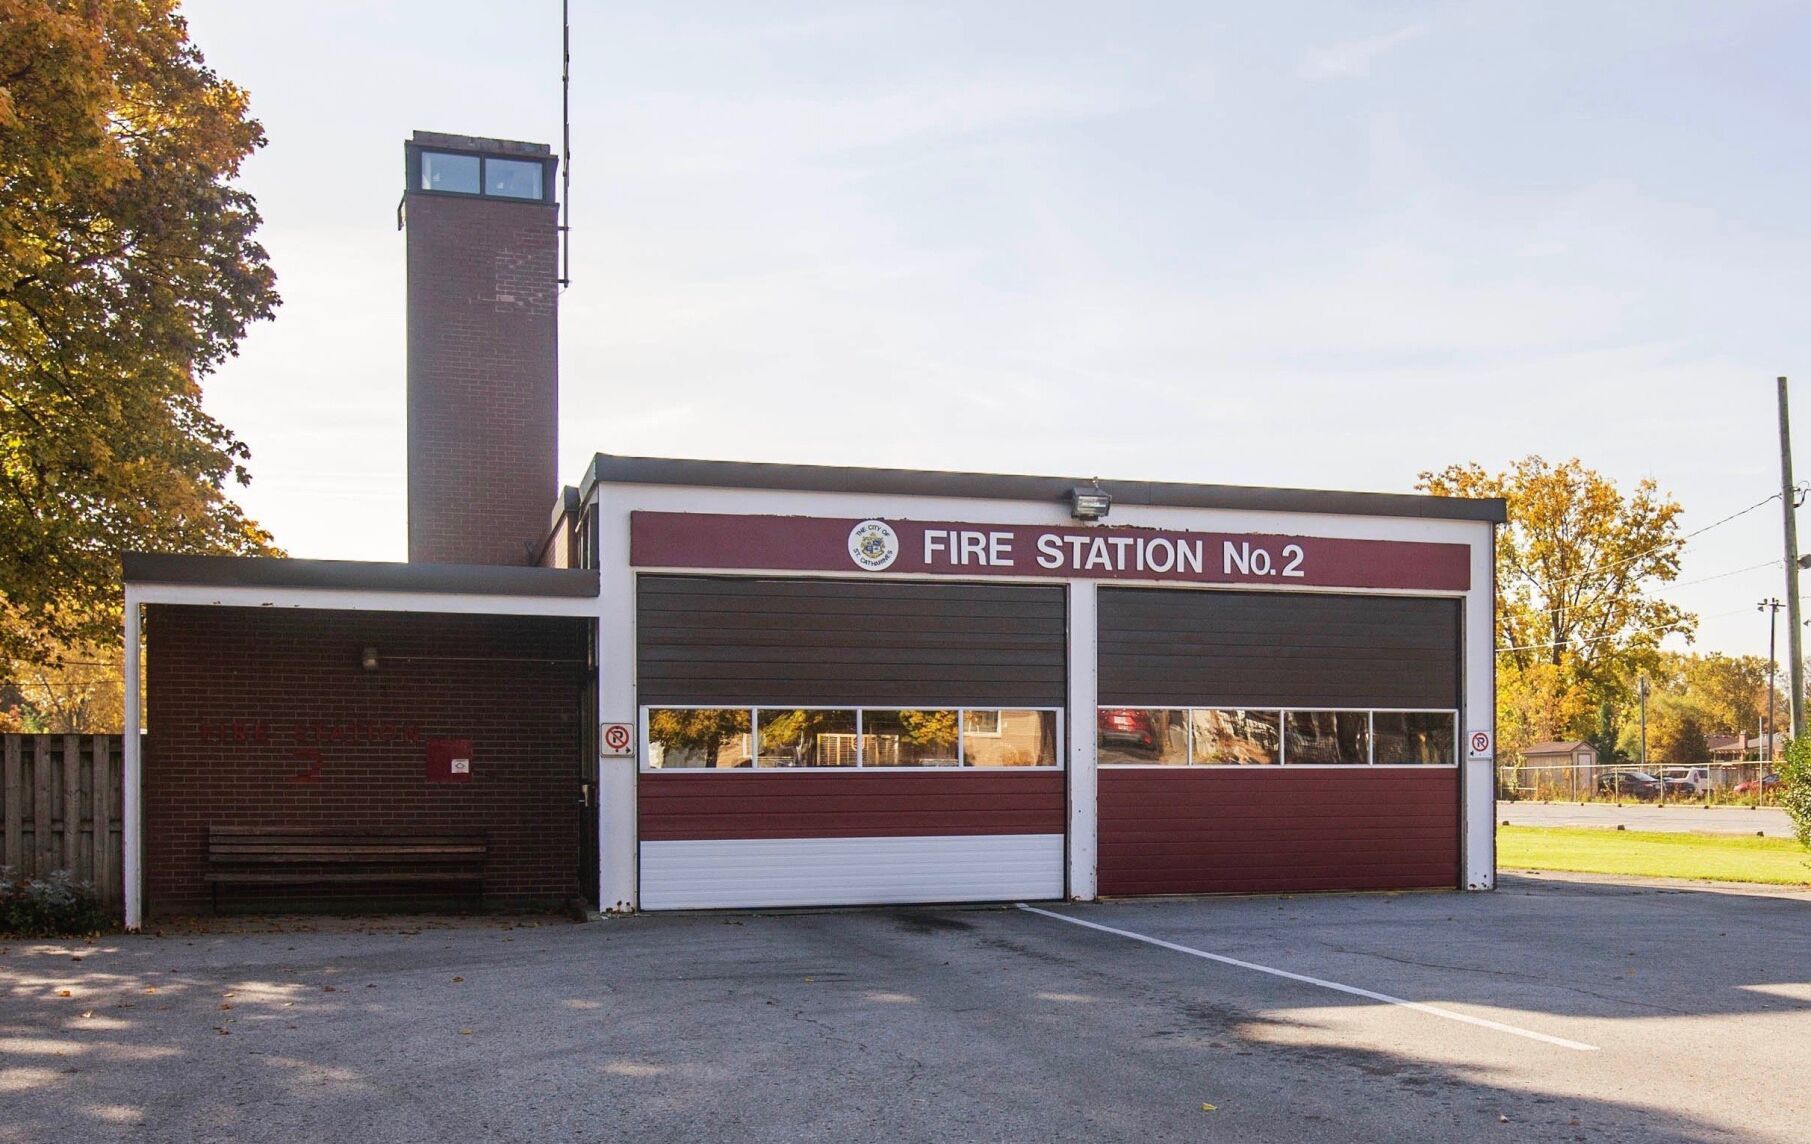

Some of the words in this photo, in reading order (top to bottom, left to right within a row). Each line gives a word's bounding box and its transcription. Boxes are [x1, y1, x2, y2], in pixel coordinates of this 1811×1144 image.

[856, 527, 867, 536] THE
[881, 529, 891, 537] OF
[923, 529, 1015, 567] FIRE
[1036, 533, 1203, 574] STATION
[200, 719, 270, 742] FIRE
[294, 721, 419, 744] STATION
[291, 748, 322, 784] 2
